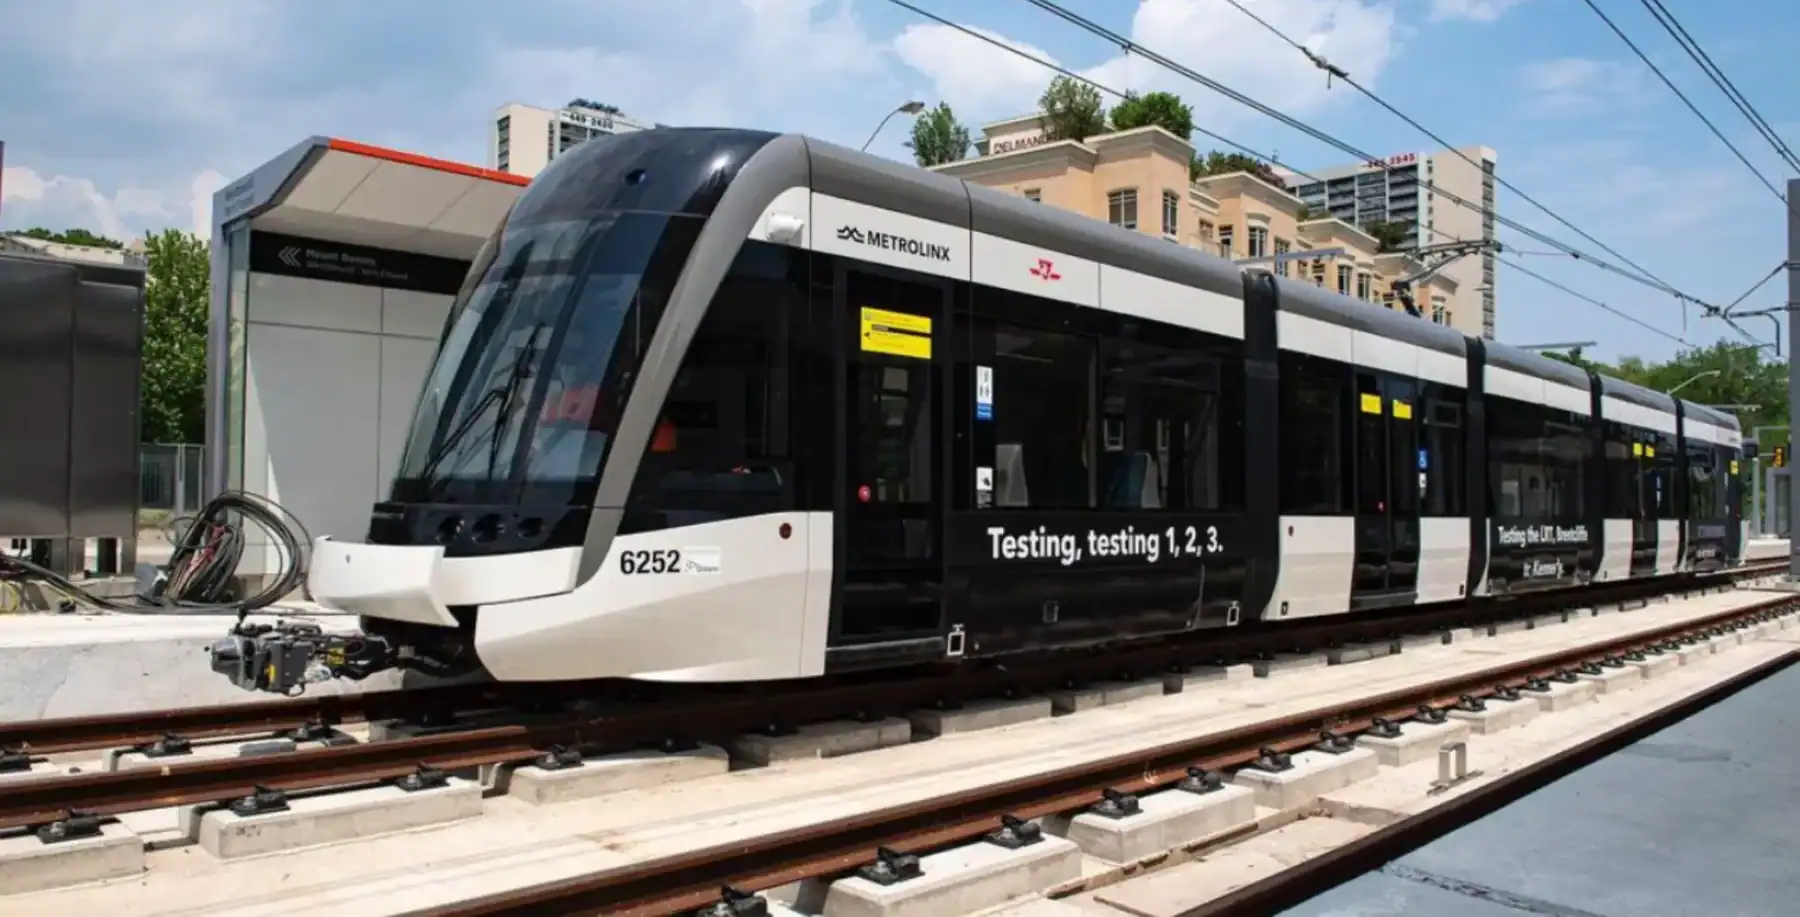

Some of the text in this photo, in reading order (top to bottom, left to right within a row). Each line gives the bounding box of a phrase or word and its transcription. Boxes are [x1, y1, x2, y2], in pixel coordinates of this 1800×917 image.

[867, 230, 951, 262] METROLINX
[987, 525, 1224, 566] Testing, testing 1, 2, 3.
[1498, 525, 1526, 548] Testing
[1527, 525, 1539, 544] the
[620, 549, 681, 575] 6252
